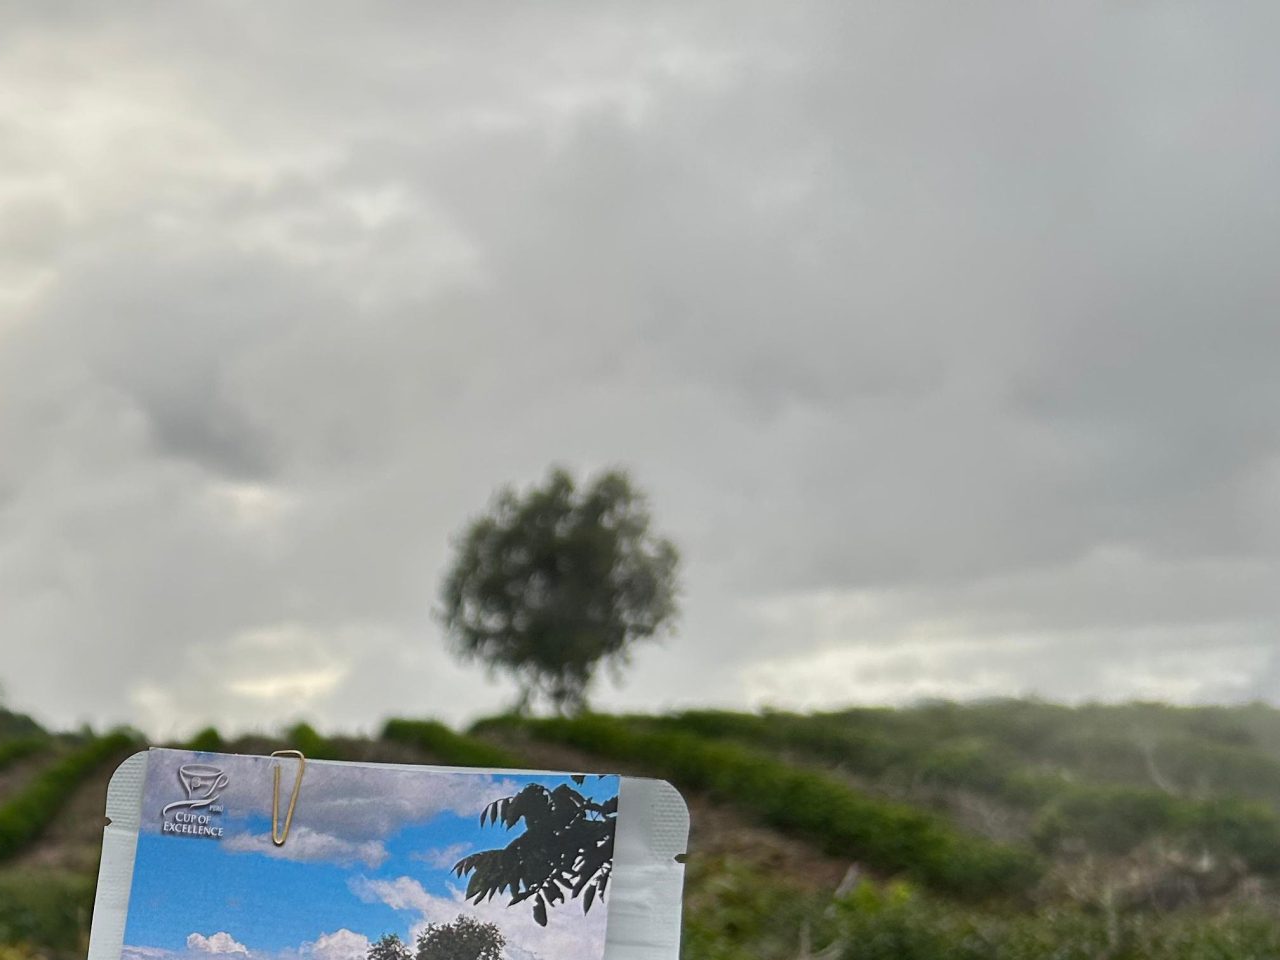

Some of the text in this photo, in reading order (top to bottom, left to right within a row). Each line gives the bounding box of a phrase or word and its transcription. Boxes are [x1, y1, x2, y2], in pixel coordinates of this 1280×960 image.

[175, 812, 212, 824] CUP OF
[163, 821, 224, 837] EXCELLENCE
